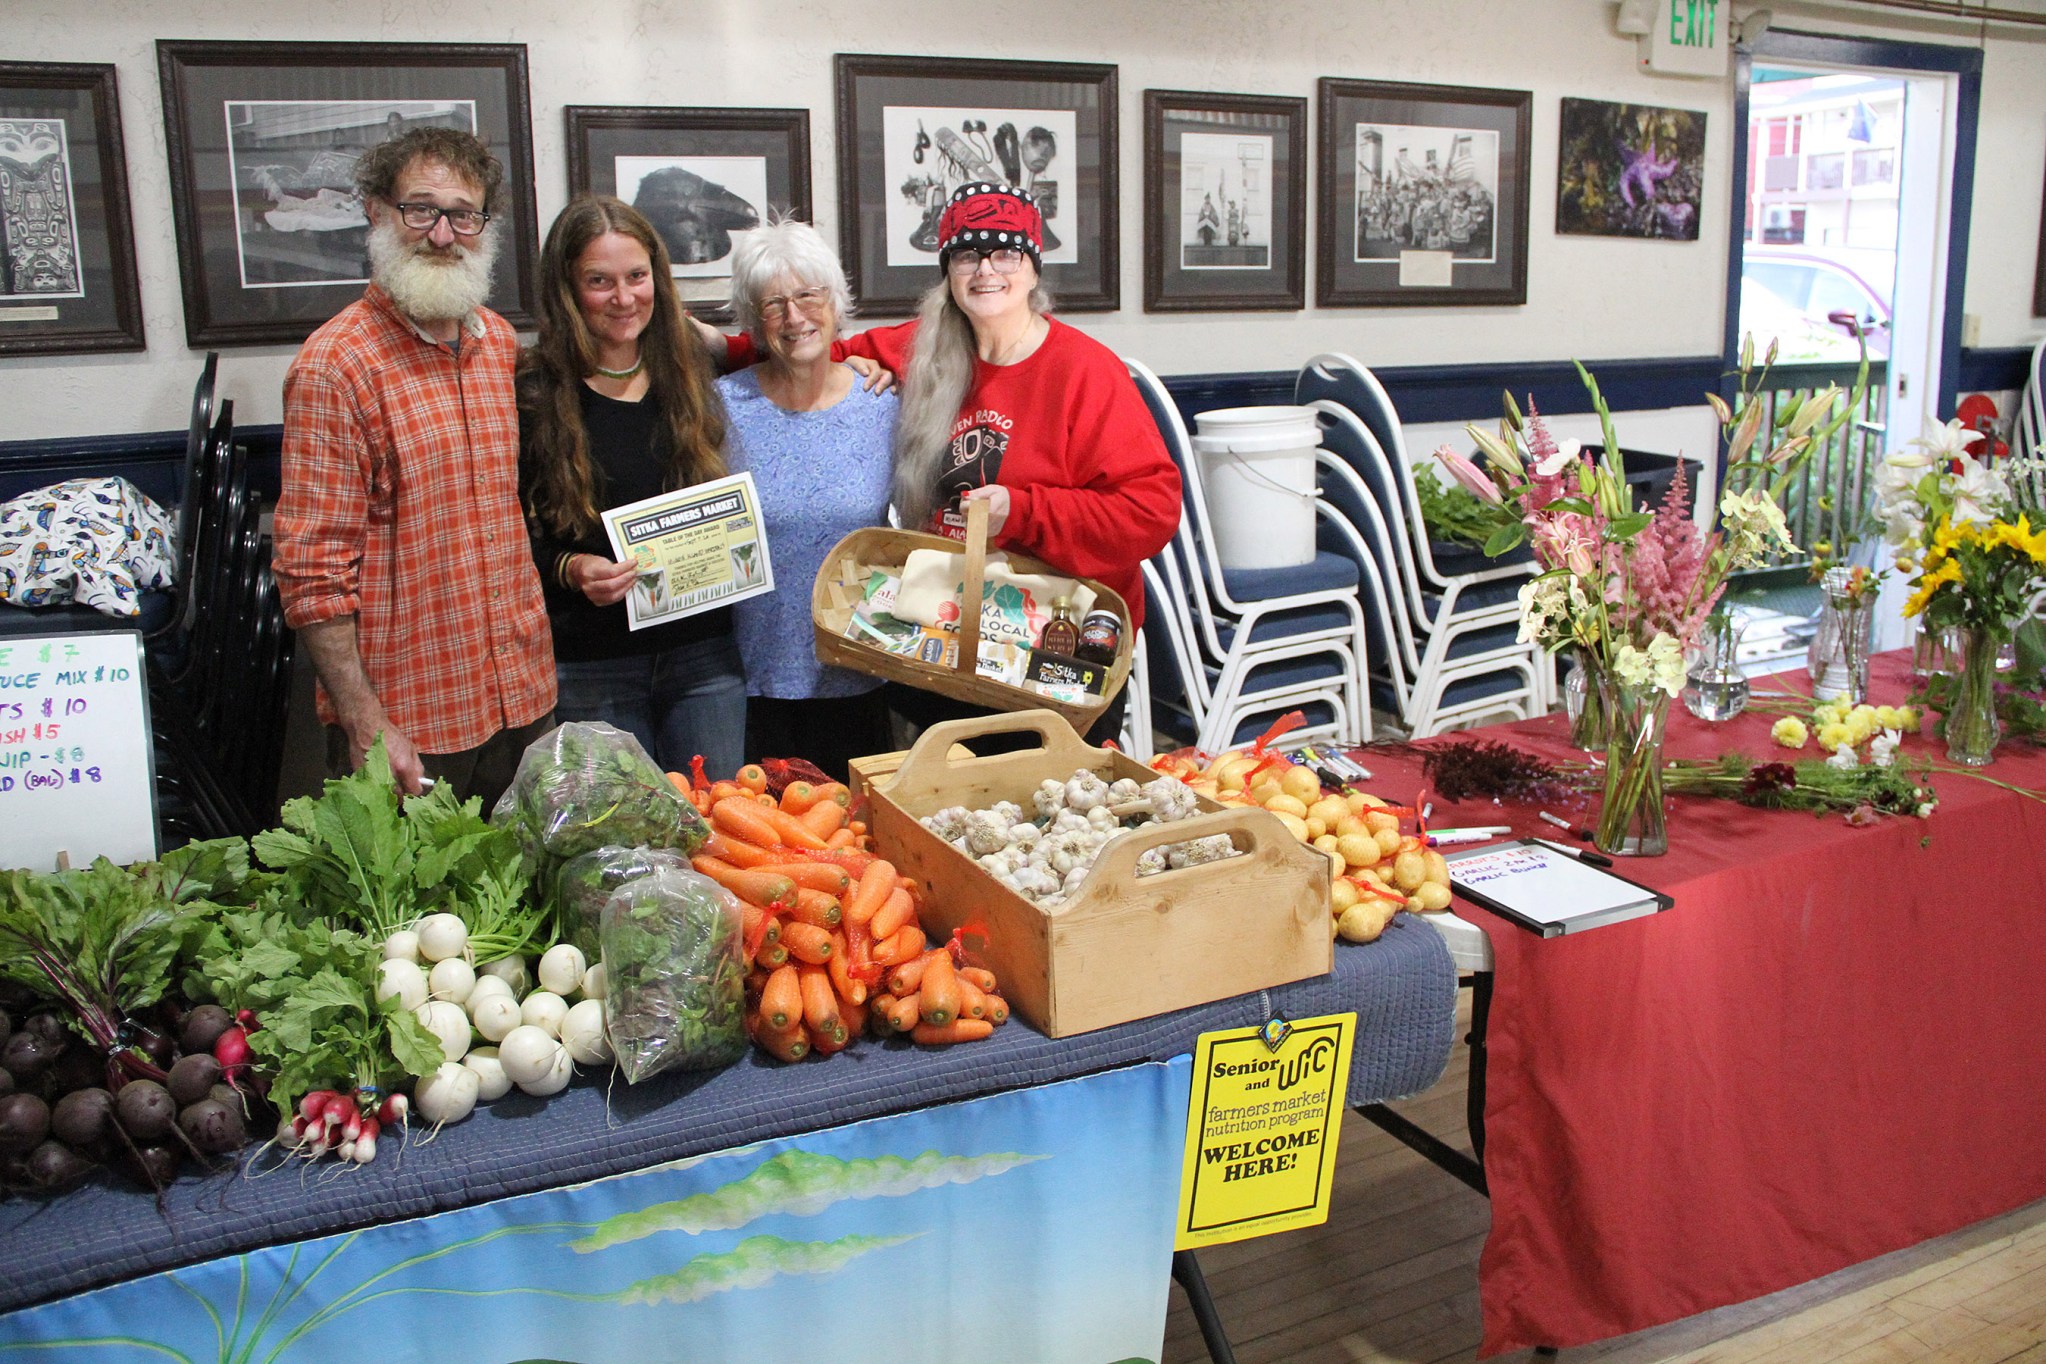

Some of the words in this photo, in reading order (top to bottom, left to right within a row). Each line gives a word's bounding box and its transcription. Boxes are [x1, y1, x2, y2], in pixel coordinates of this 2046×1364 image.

[1671, 0, 1718, 48] EXIT
[630, 520, 659, 537] SITKA
[659, 508, 702, 528] FARMERS
[702, 497, 738, 516] MARKET
[981, 620, 1030, 638] LOCAL
[0, 672, 41, 689] UCE
[56, 670, 87, 685] MIX
[1448, 855, 1501, 870] ARROTS
[1213, 1058, 1281, 1078] Senior
[1245, 1078, 1270, 1091] and
[1208, 1102, 1270, 1123] farmers
[1272, 1089, 1327, 1113] market
[1205, 1118, 1266, 1138] nutrition
[1268, 1107, 1325, 1130] program
[1203, 1128, 1321, 1165] WELCOME
[1222, 1152, 1298, 1183] HERE!
